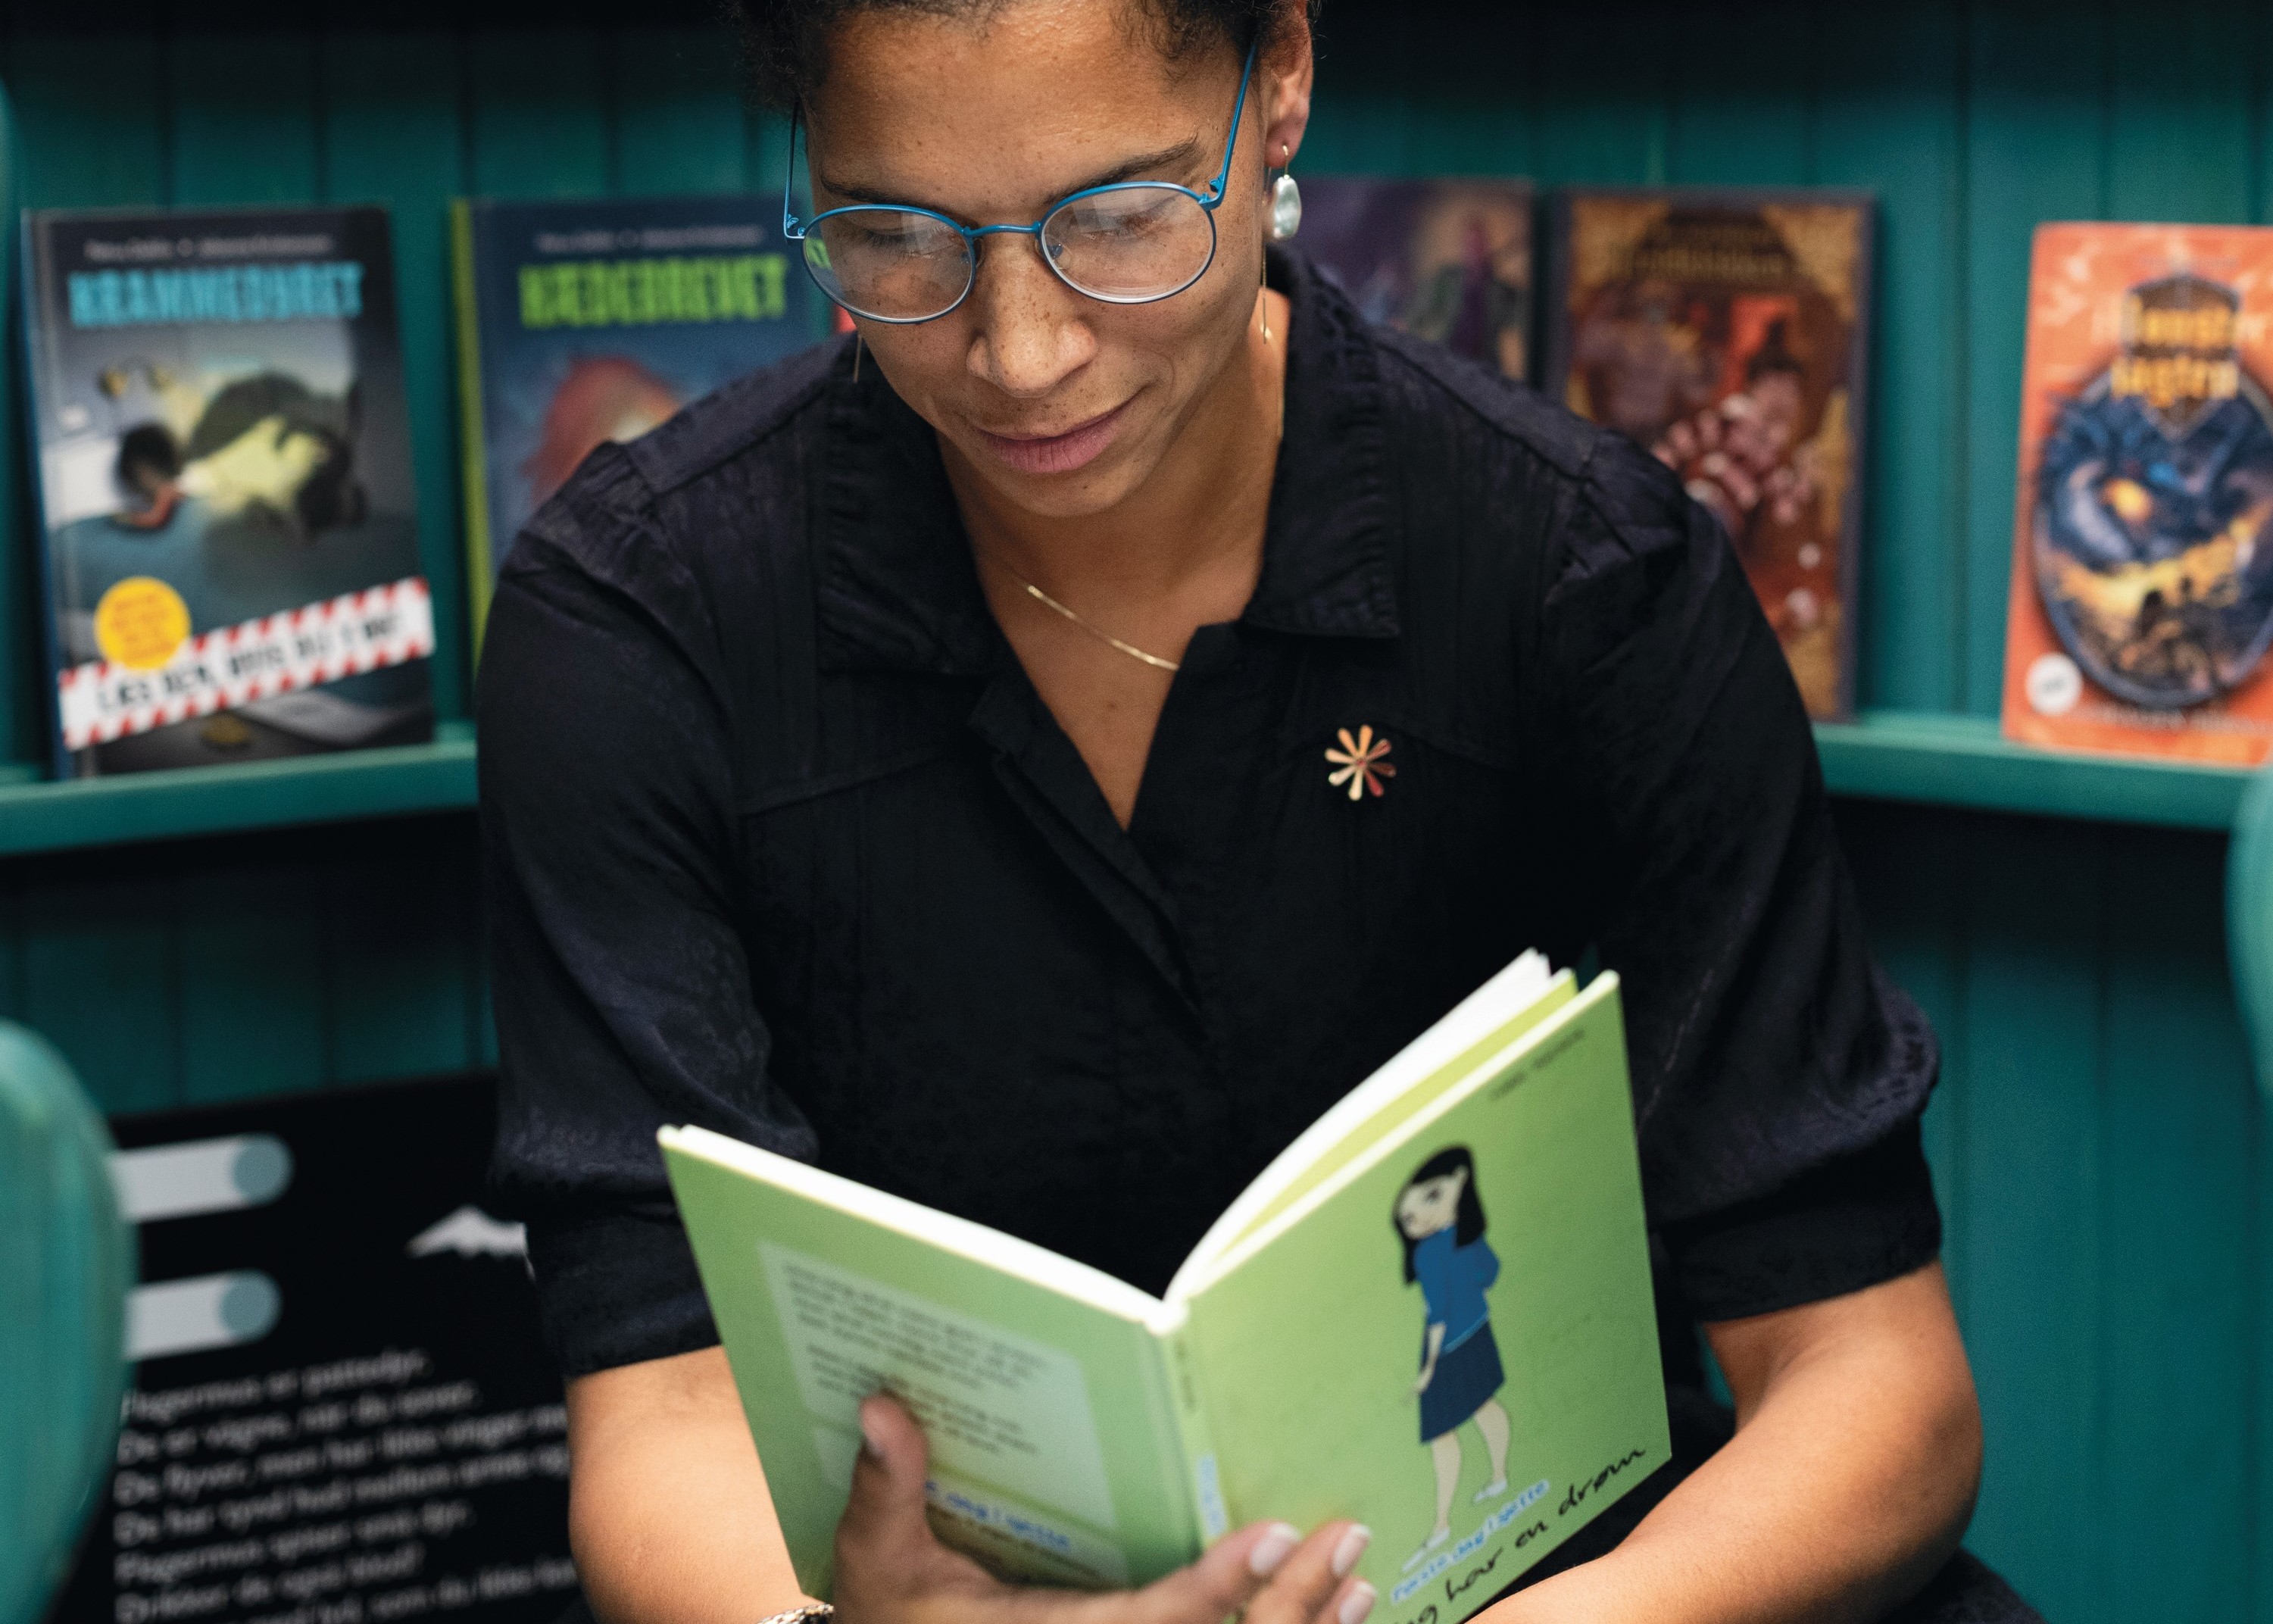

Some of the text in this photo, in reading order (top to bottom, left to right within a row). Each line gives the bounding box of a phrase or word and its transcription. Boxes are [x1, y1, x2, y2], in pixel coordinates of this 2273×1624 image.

[1444, 1545, 1503, 1601] har
[1514, 1520, 1548, 1549] en
[1557, 1448, 1647, 1516] drøm
